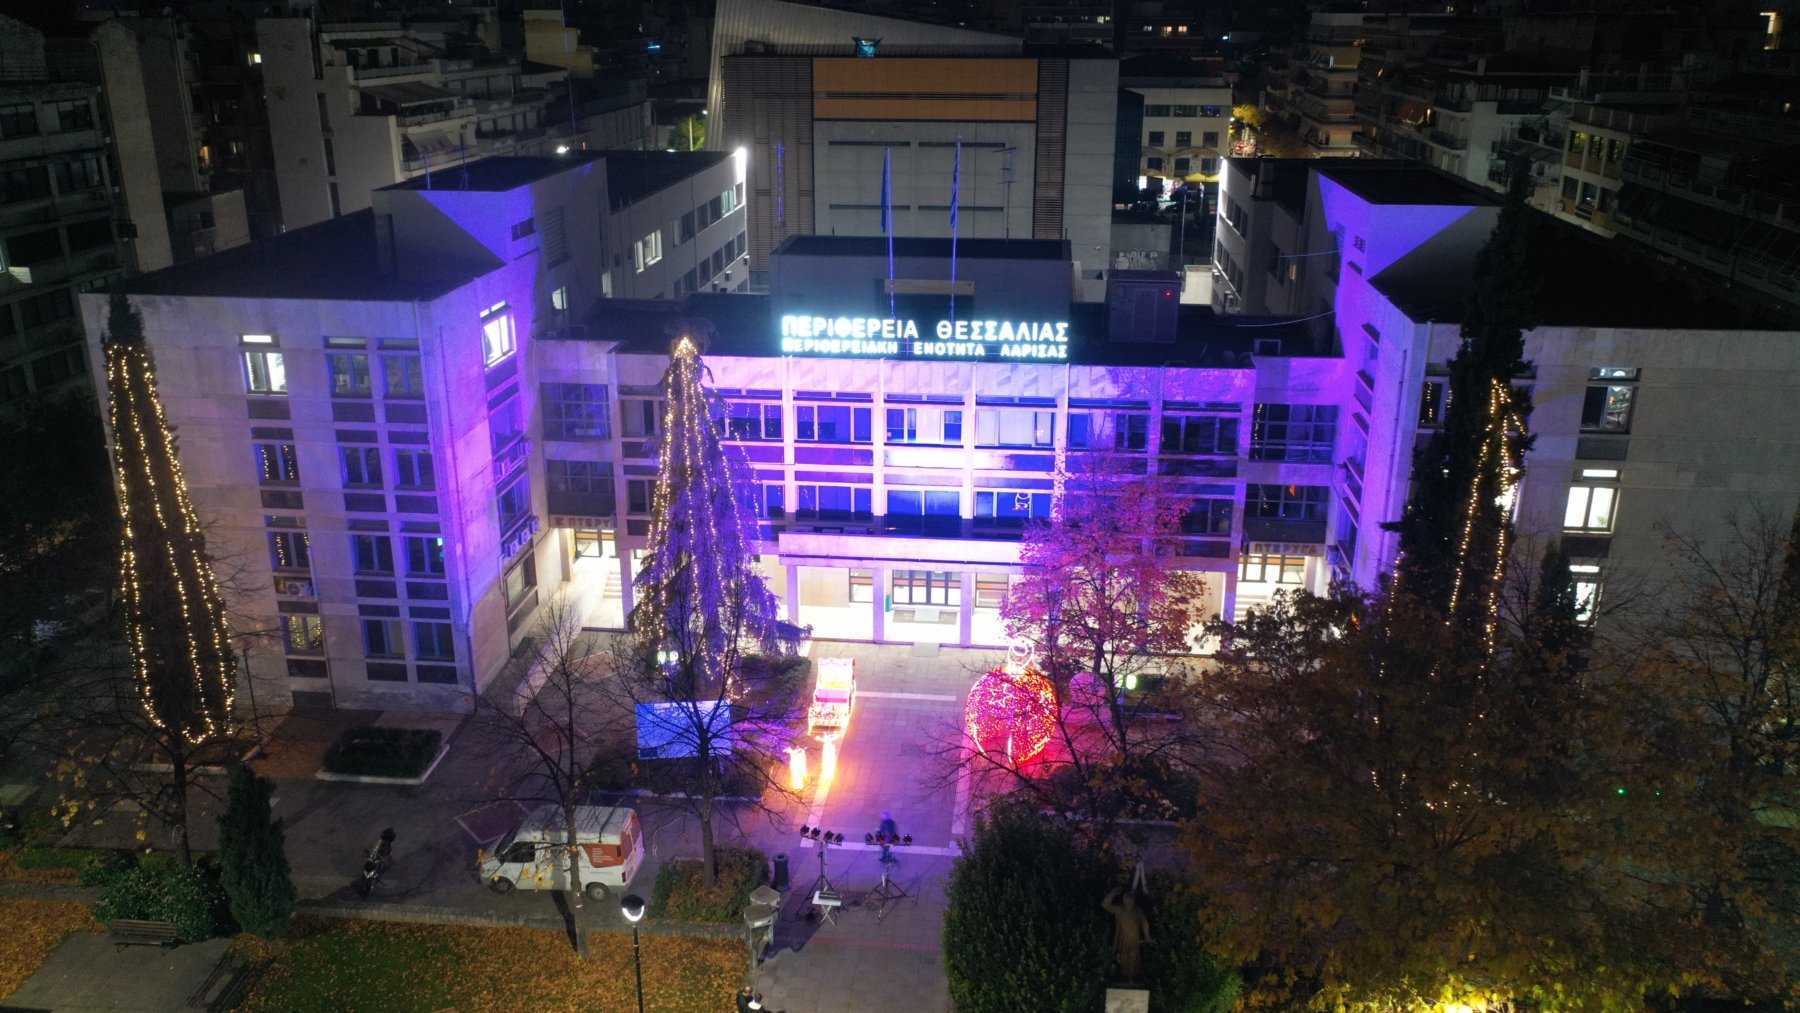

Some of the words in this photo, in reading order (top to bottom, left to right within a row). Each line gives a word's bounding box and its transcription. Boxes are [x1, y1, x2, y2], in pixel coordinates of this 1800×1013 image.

[781, 315, 919, 338] ΠΕΡΙΦΕΡΕΙΑ
[936, 320, 1069, 342] ΘΕΣΣΑΛΙΑΣ
[781, 338, 898, 353] ΠΕΡΙΦΕΡΕΙΑΚΗ
[913, 341, 985, 356] ΕΝΟΤΗΤΑ
[1000, 344, 1068, 358] ΛΑΡΙΣΑΣ
[568, 517, 613, 528] ΠΤΕΡΥ
